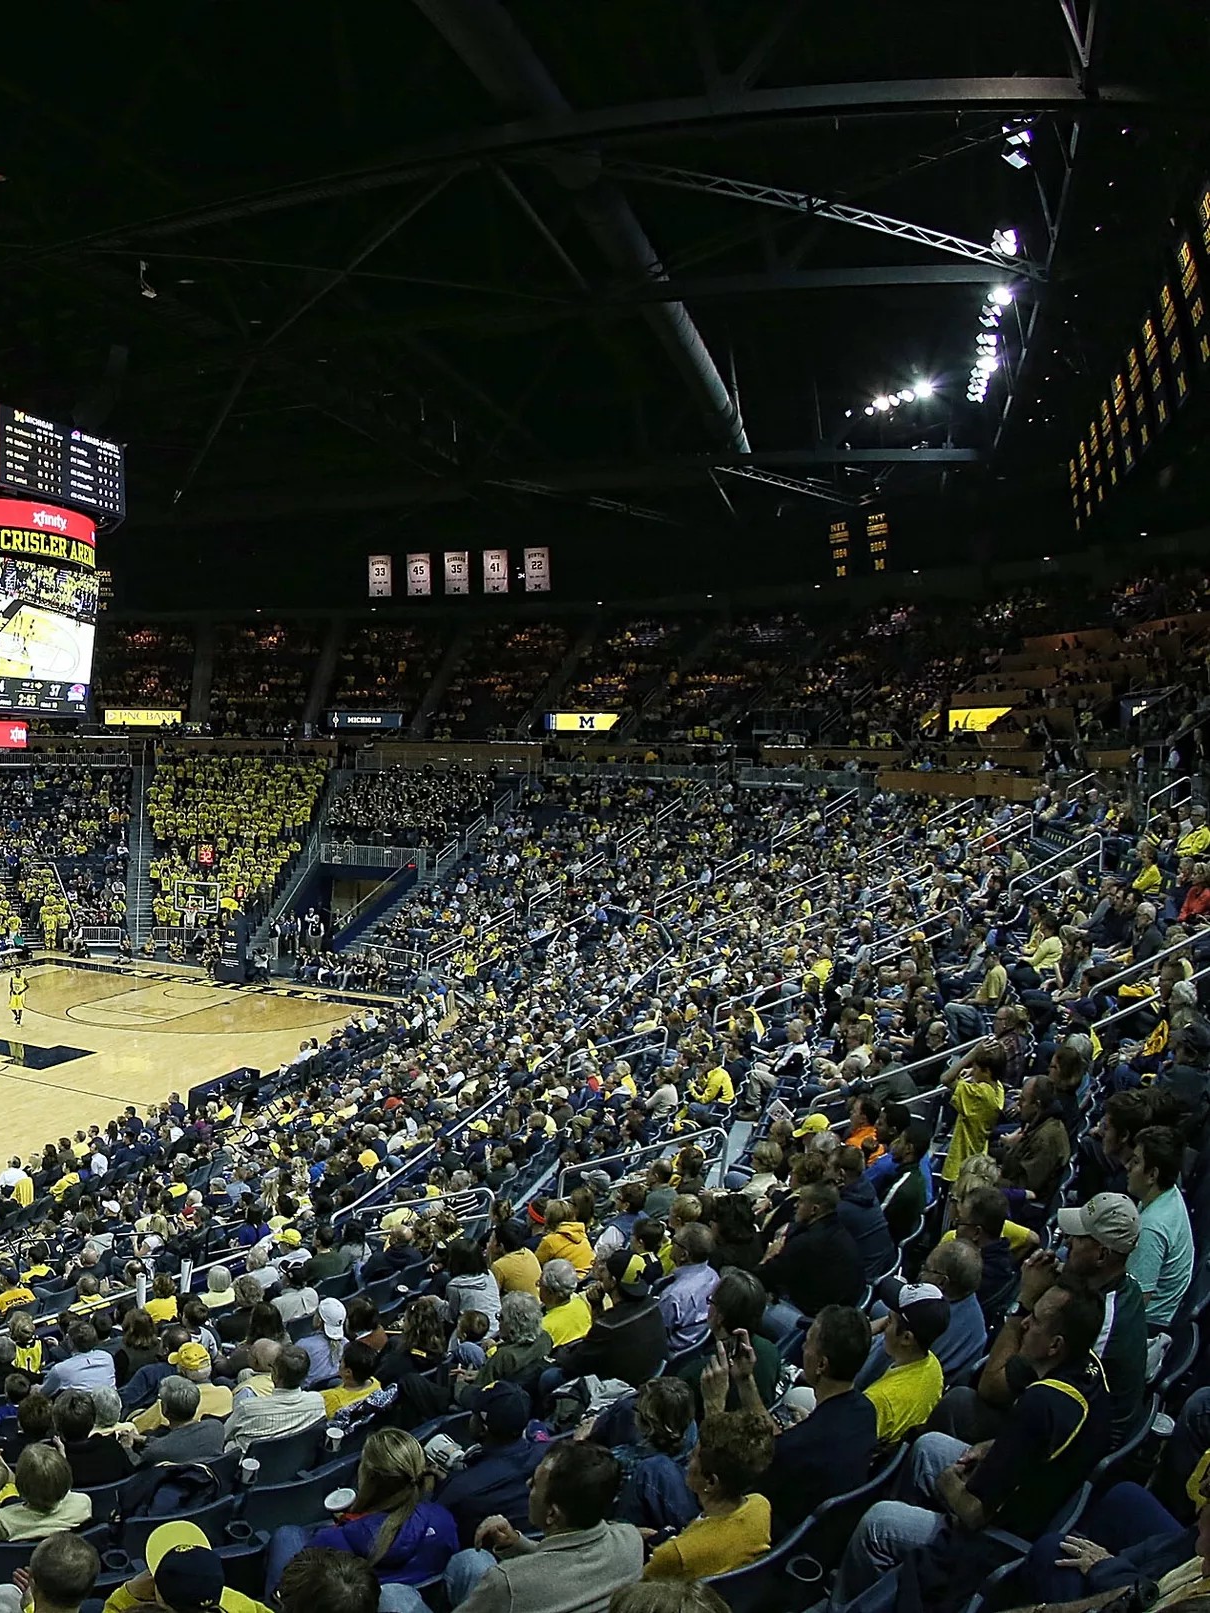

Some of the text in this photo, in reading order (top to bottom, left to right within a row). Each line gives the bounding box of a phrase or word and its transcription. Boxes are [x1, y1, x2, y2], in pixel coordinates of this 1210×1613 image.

[25, 415, 54, 430] MICHIGAN
[0, 529, 95, 568] CRISLER AREN
[413, 566, 424, 575] 45
[451, 564, 462, 573] 35
[490, 563, 500, 572] 41
[532, 561, 542, 570] 22
[375, 568, 385, 576] 33
[50, 684, 61, 696] 37
[18, 694, 36, 706] 2:55
[120, 712, 178, 720] PNC BANK
[579, 716, 594, 728] M
[200, 851, 213, 863] 32
[121, 969, 326, 1000] MICHIGAN
